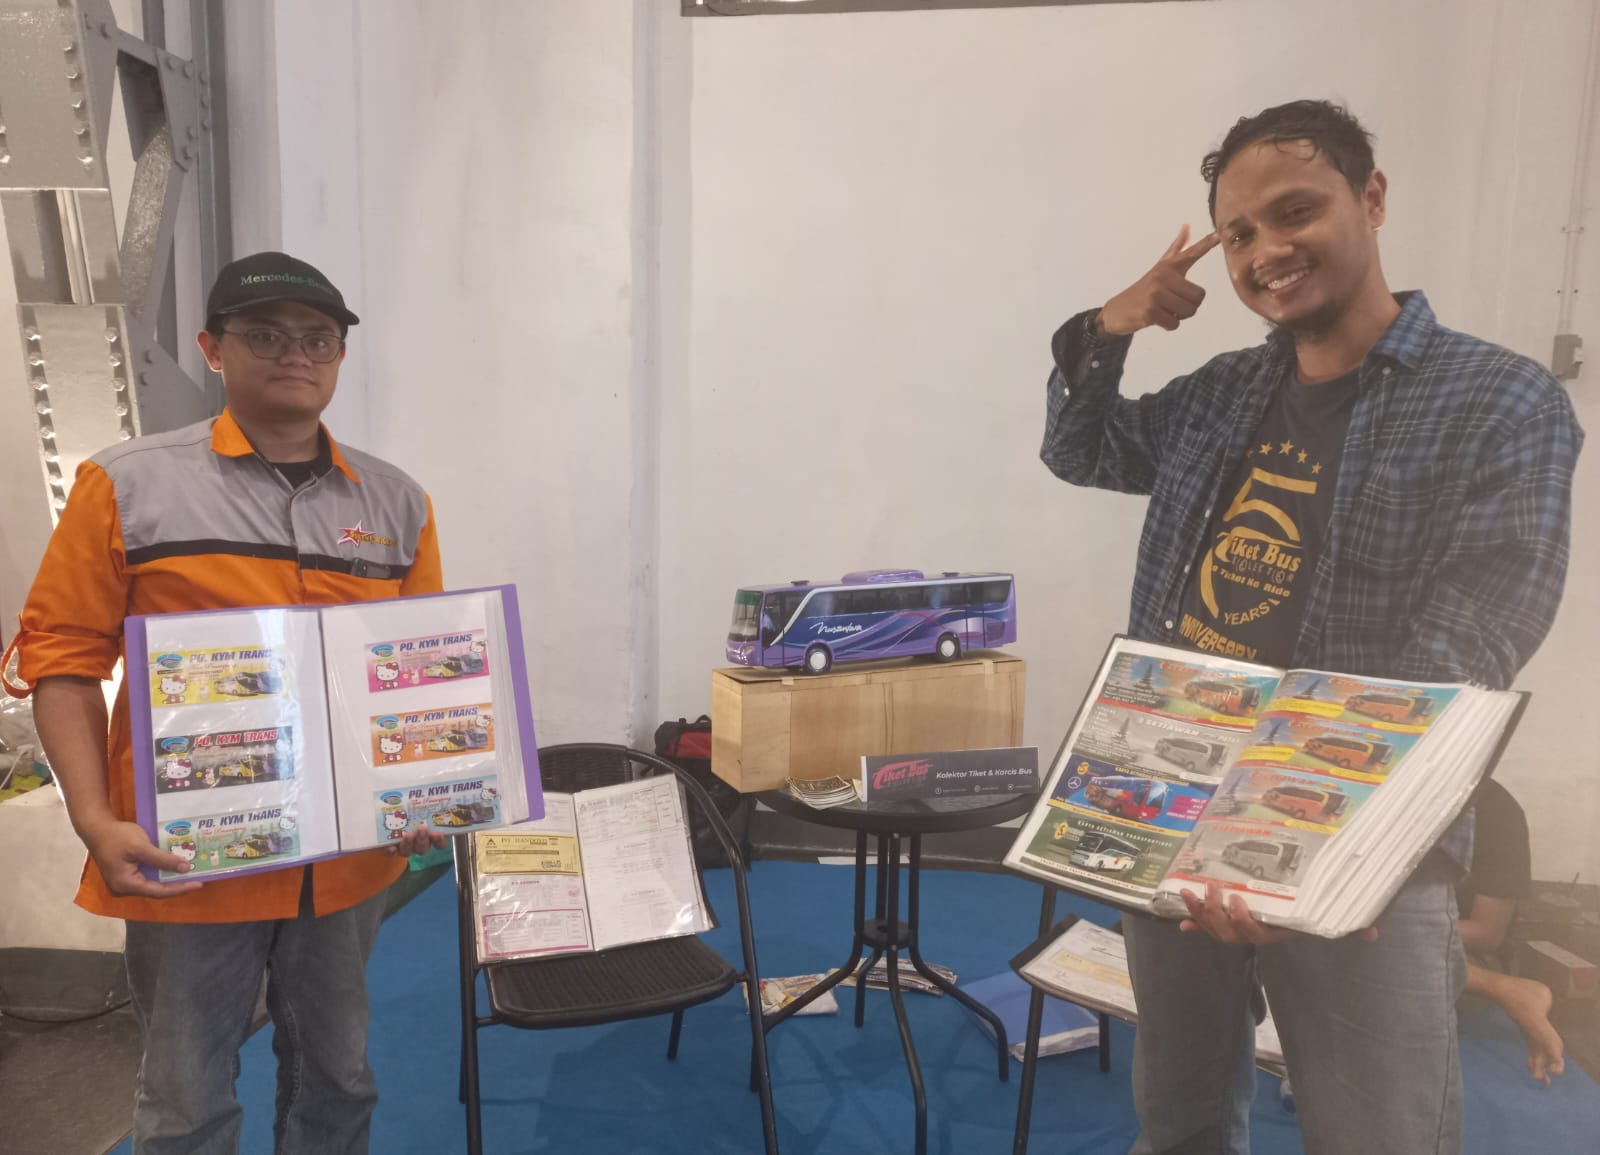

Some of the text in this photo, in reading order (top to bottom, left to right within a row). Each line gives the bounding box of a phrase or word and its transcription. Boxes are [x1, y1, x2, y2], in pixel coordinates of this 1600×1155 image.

[1261, 543, 1301, 572] Bus
[1224, 602, 1270, 625] YEARS
[419, 638, 440, 649] KYM
[443, 633, 472, 645] TRANS
[424, 710, 445, 721] KYM
[448, 706, 478, 718] TRANS
[216, 733, 240, 745] KYM
[244, 730, 279, 741] TRANS
[936, 770, 967, 779] Kolektor
[969, 769, 986, 777] Tiket
[995, 768, 1017, 776] Karcis
[1018, 767, 1032, 775] Bus
[428, 785, 449, 797] KYM
[453, 780, 483, 793] TRANS
[220, 814, 244, 825] KYM
[248, 808, 282, 822] TRANS
